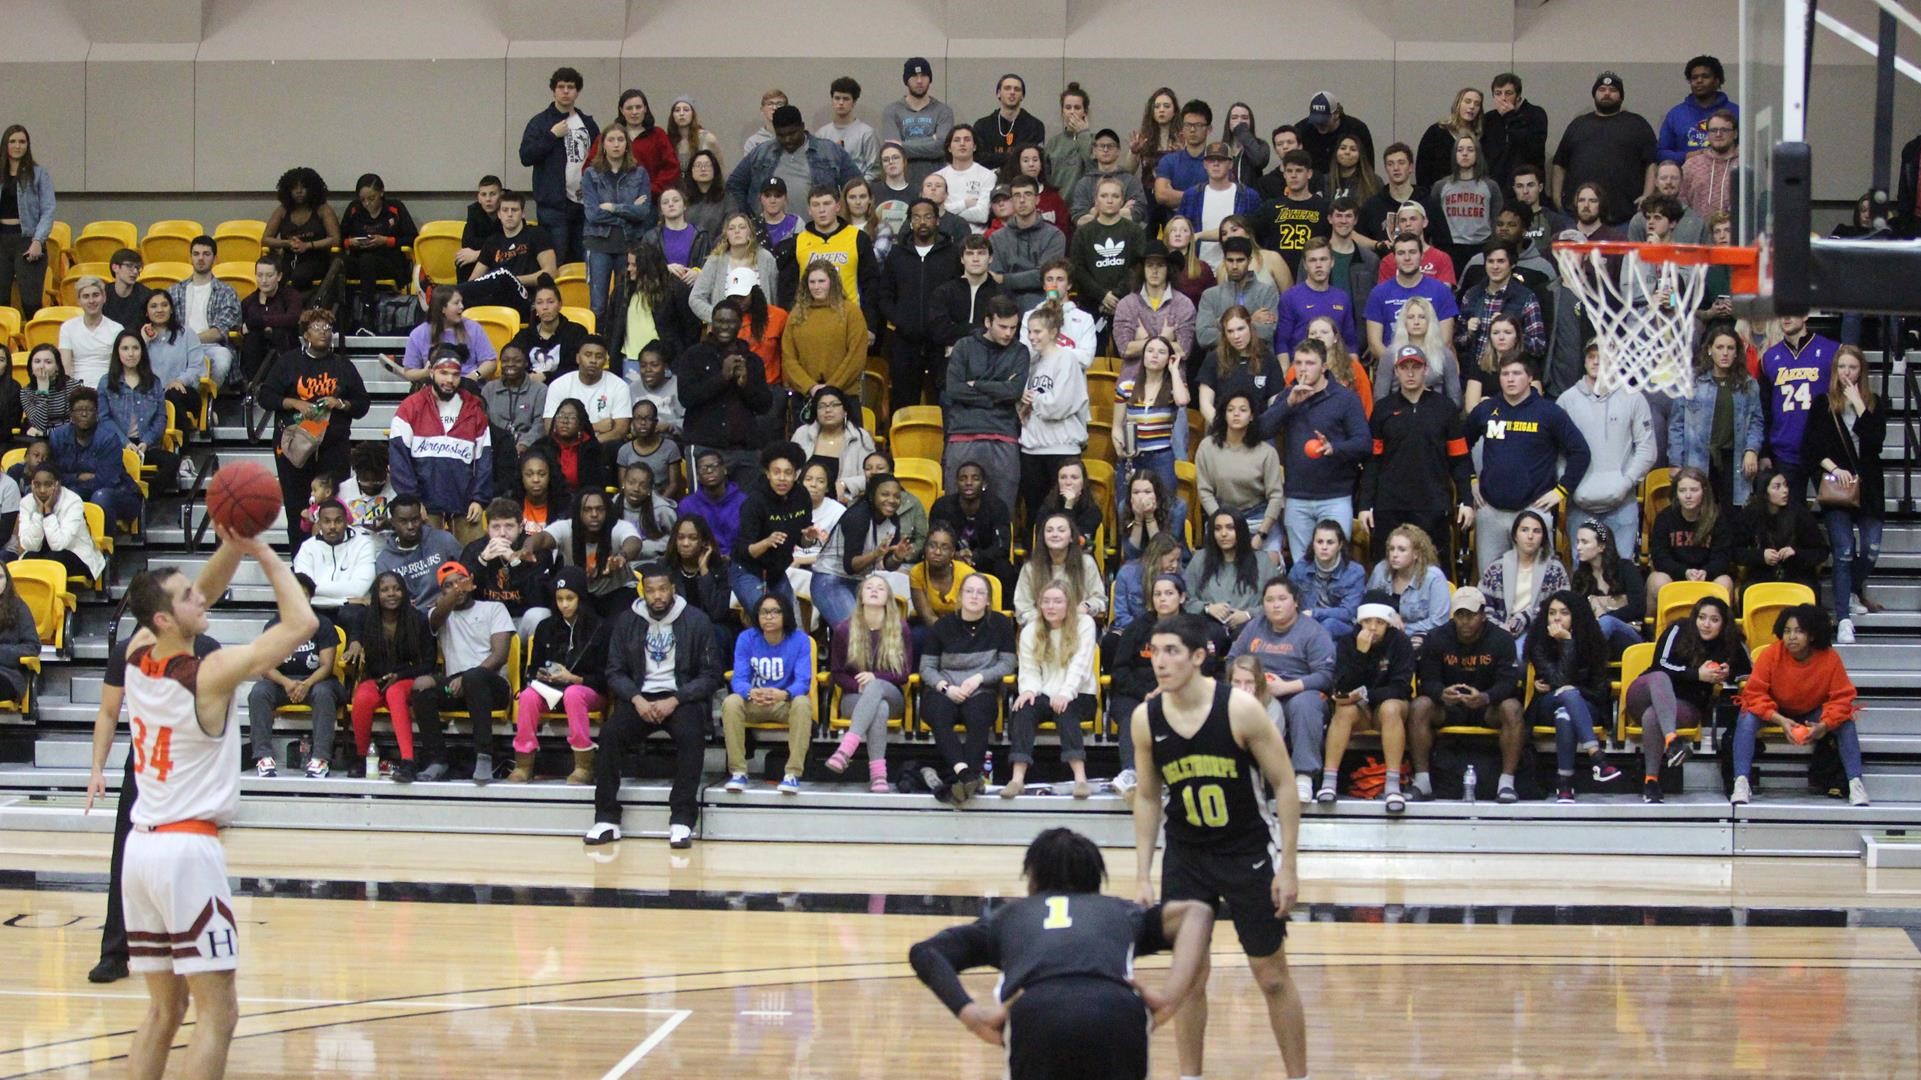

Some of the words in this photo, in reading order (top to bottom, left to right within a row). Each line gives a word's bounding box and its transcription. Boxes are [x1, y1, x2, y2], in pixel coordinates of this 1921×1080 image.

[1446, 193, 1486, 206] HENDRIX
[1447, 206, 1485, 217] COLLEGE
[1275, 208, 1319, 223] LAKERS
[1280, 224, 1312, 250] 23
[1096, 258, 1125, 268] adidas
[1775, 367, 1819, 386] LAKERS
[1781, 382, 1812, 412] 24
[132, 717, 174, 783] 34
[1182, 784, 1229, 828] 10
[1043, 896, 1072, 929] 1
[207, 929, 235, 959] H
